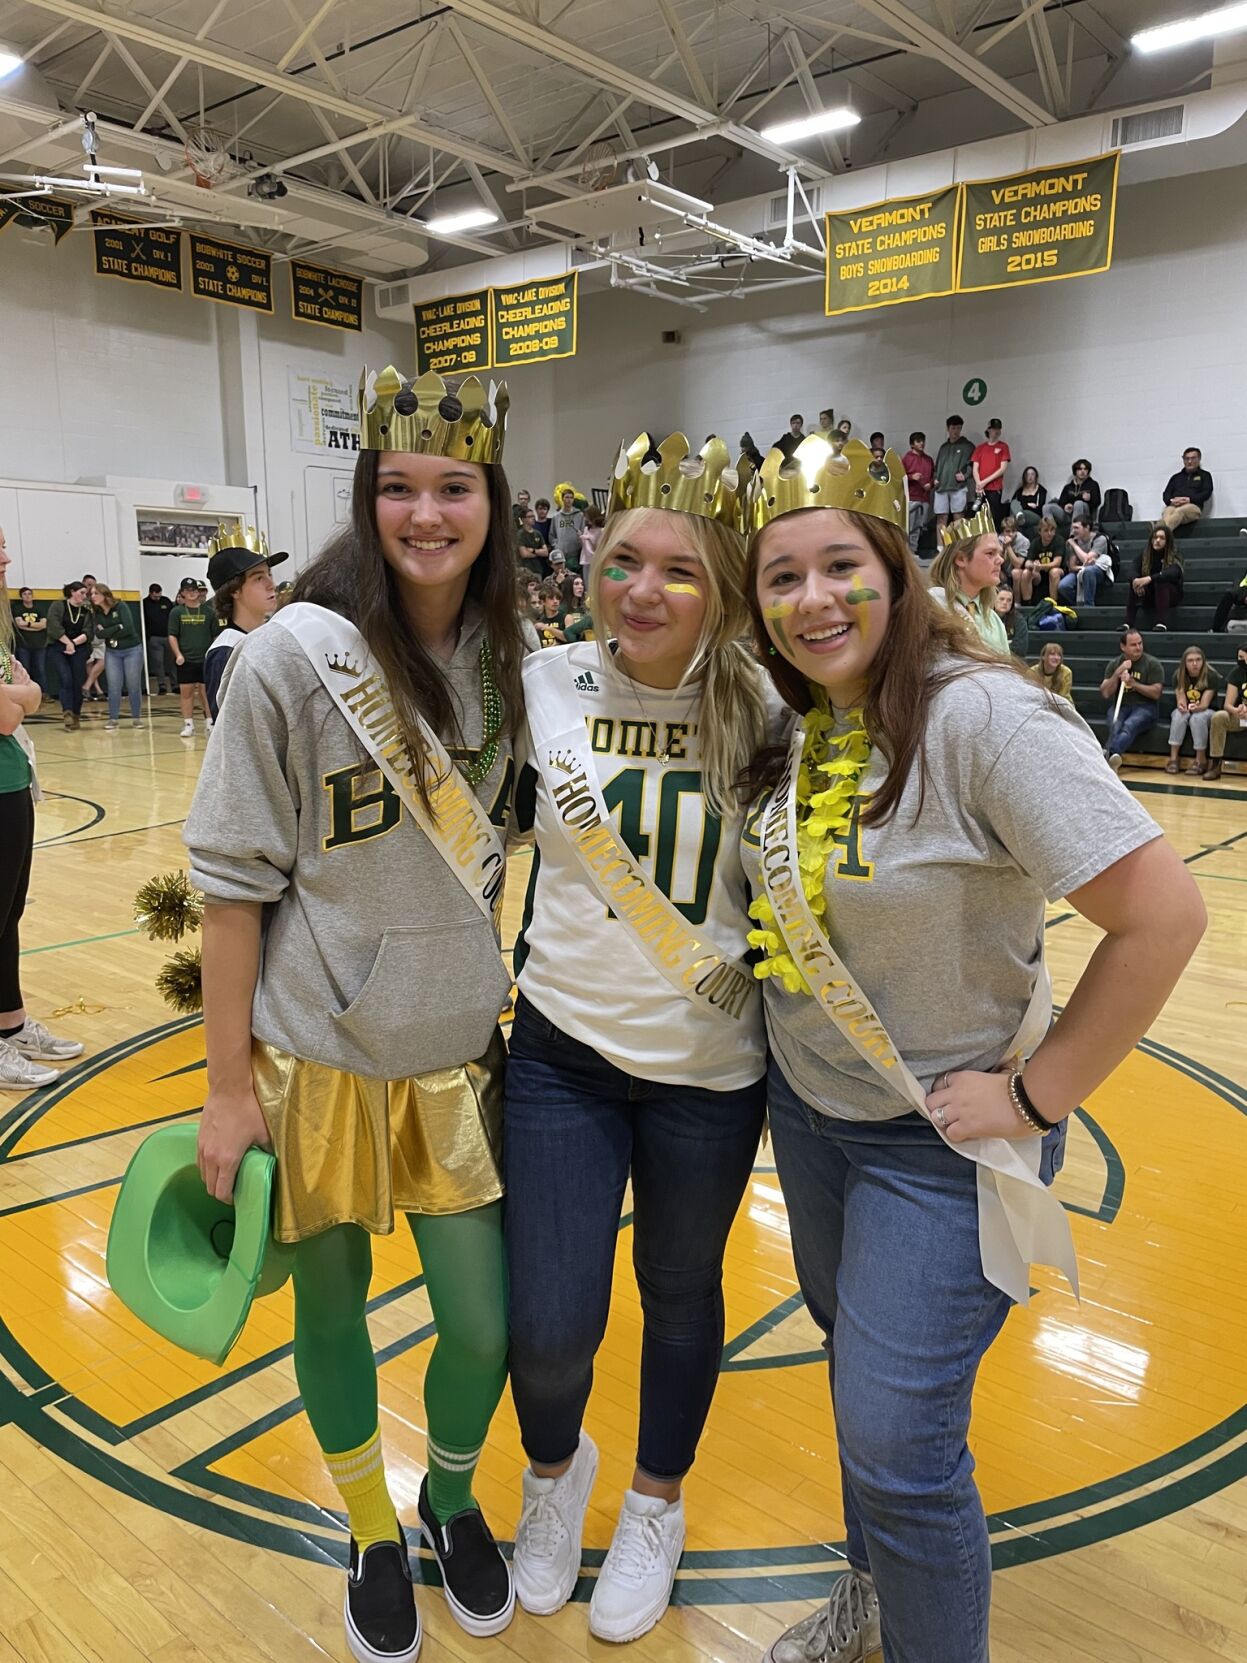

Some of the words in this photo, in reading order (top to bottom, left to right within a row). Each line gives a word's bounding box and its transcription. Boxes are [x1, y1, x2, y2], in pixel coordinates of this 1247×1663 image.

[991, 172, 1088, 205] VERMONT
[28, 200, 65, 217] SOCCER
[849, 203, 932, 234] VERMONT
[975, 214, 1017, 231] STATE
[1020, 194, 1102, 224] CHAMPIONS
[96, 216, 145, 237] ACAMY
[149, 230, 177, 245] GOLF
[835, 238, 873, 260] STATE
[876, 223, 946, 252] CHAMPIONS
[977, 235, 1008, 254] GIRLS
[1011, 219, 1095, 249] SNOWBOARDING
[101, 256, 128, 273] STATE
[131, 262, 177, 283] CHAMPIONS
[195, 242, 233, 261] BOBWHITE
[236, 253, 266, 270] SOCCER
[839, 263, 864, 281] BOYS
[867, 247, 940, 275] SNOWBOARDING
[1006, 249, 1058, 273] 2015
[198, 277, 224, 293] STATE
[226, 283, 267, 304] CHAMPIONS
[538, 282, 566, 299] DIVISION
[867, 275, 910, 297] 2014
[298, 301, 320, 316] STATE
[322, 307, 358, 325] CHAMPIONS
[456, 299, 481, 314] DIVISION
[498, 298, 571, 323] CHEERLEADING
[420, 315, 485, 338] CHEERLEADING
[502, 317, 566, 340] CHAMPIONS
[424, 333, 481, 353] CHAMPIONS
[509, 336, 559, 356] 2008-09
[430, 350, 476, 369] 2007-08
[967, 382, 982, 401] 4
[584, 716, 702, 759] OME
[602, 766, 723, 926] 40
[551, 771, 702, 970] HOMECOMING
[681, 953, 757, 1021] COURT
[820, 979, 898, 1070] COURT
